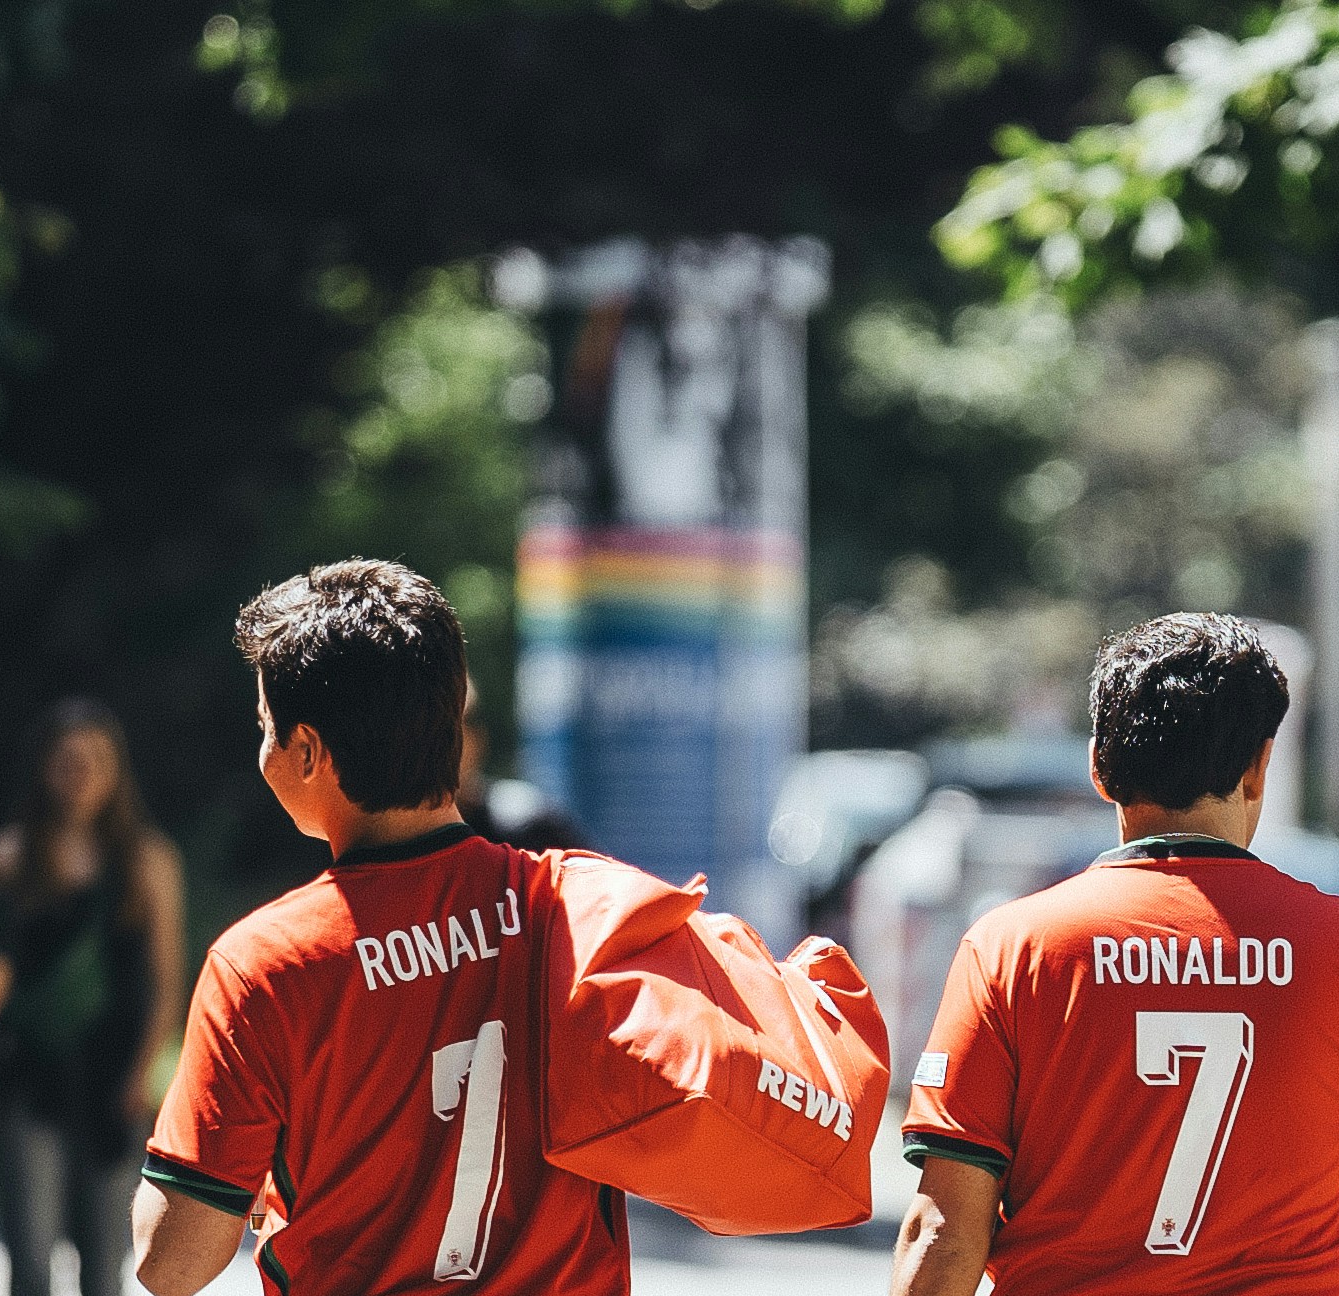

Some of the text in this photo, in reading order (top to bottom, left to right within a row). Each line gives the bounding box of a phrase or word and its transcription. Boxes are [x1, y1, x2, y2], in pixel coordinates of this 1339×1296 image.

[1093, 936, 1293, 986] RONALDO
[431, 1020, 508, 1282] 7
[757, 1058, 854, 1143] REWE
[1136, 1011, 1254, 1256] 7
